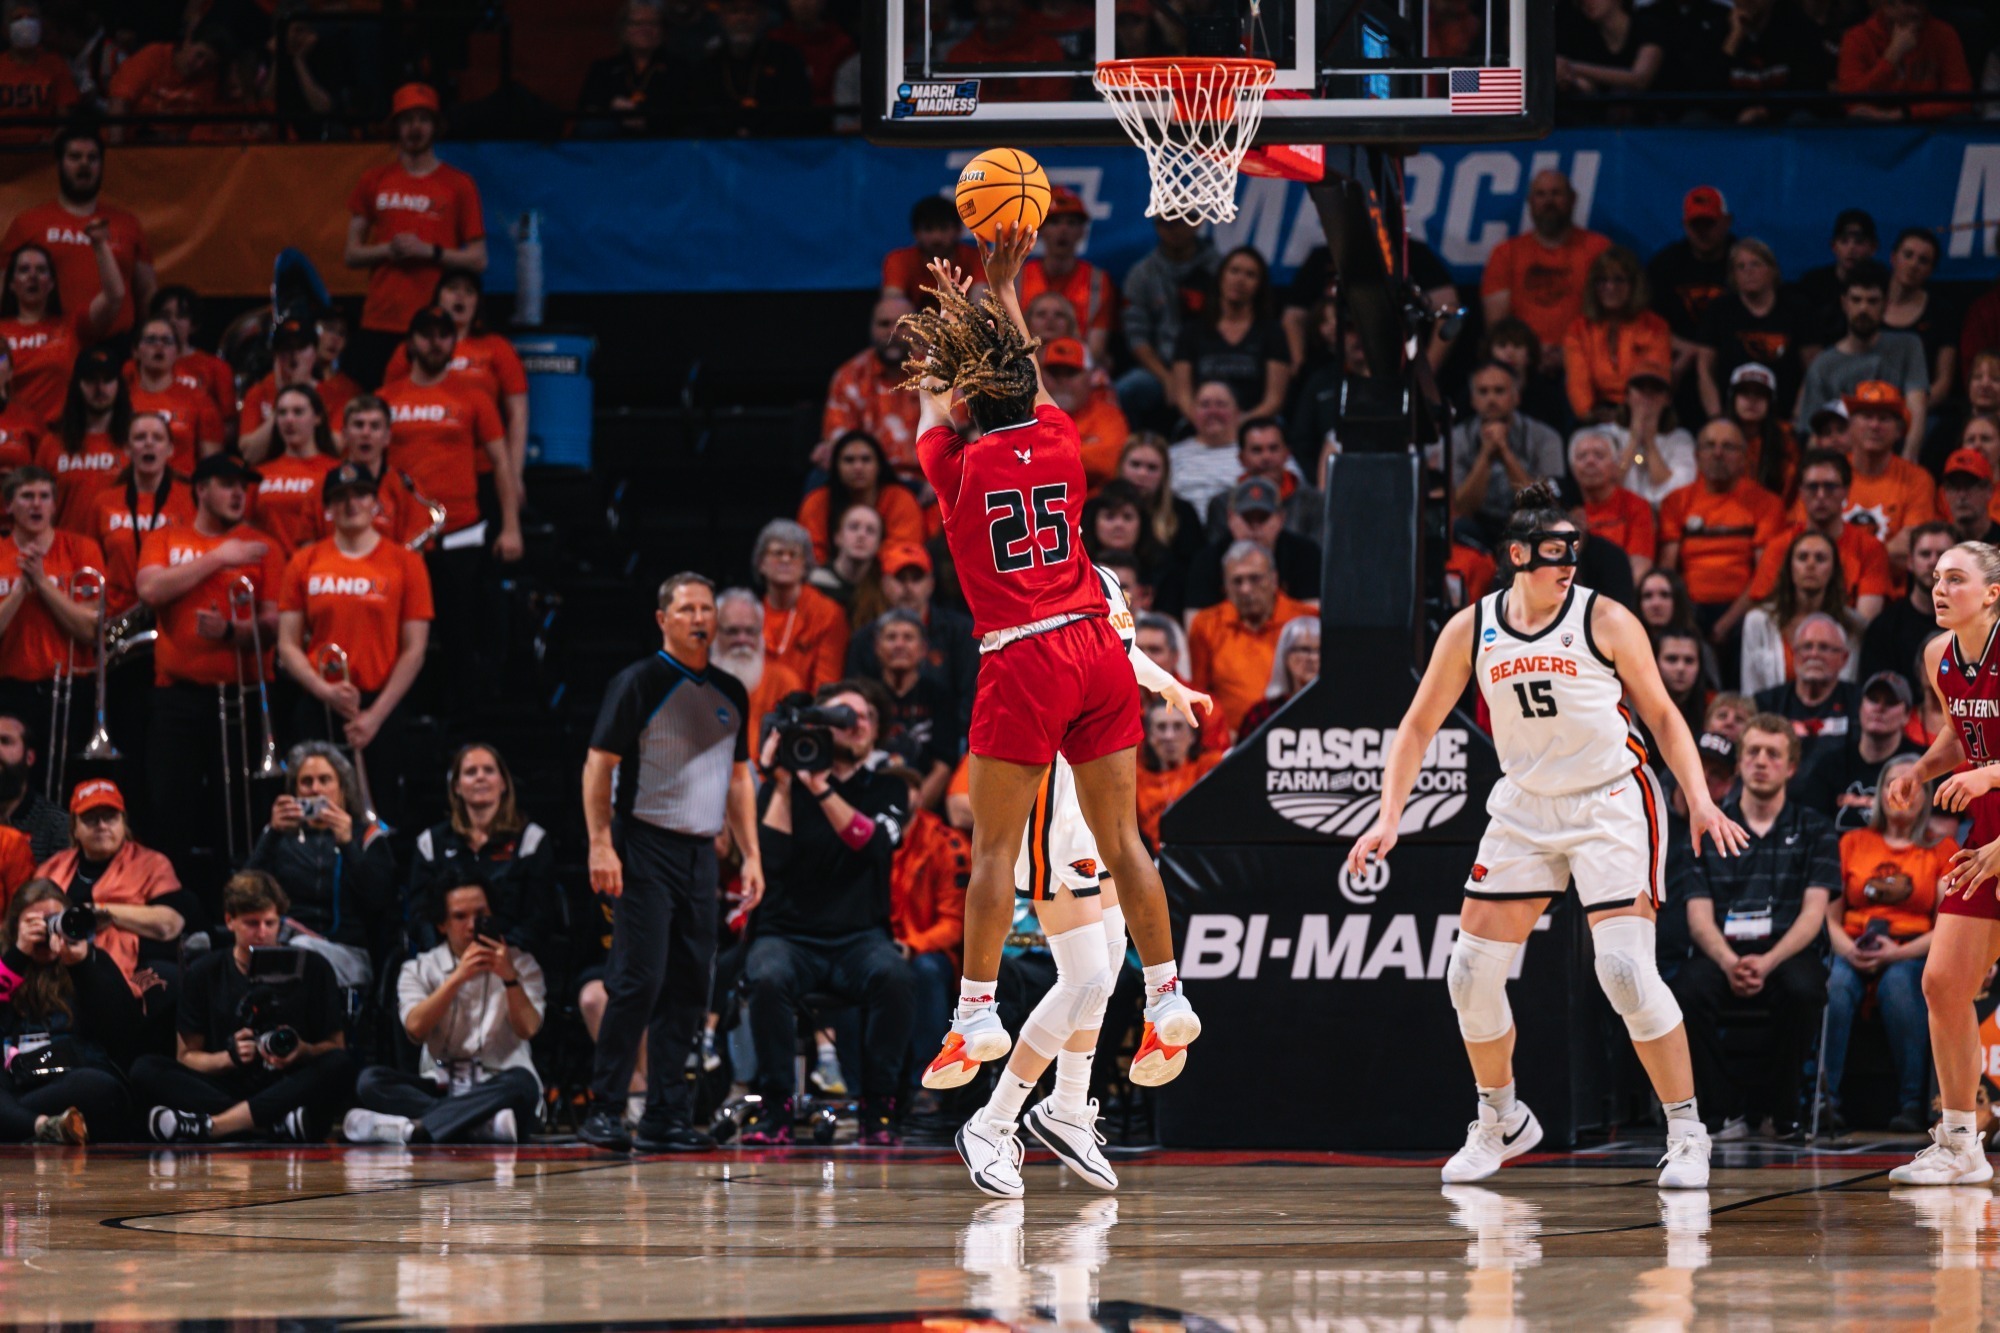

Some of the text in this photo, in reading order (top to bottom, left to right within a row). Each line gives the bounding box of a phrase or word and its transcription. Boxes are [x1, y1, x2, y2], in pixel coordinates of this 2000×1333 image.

[911, 85, 956, 98] MARCH
[916, 98, 976, 112] MADNESS
[376, 194, 428, 211] BAND
[47, 227, 92, 244] BAN
[57, 452, 114, 473] BAND
[109, 514, 167, 531] BAND
[985, 482, 1070, 573] 25
[308, 577, 371, 596] BAND
[1490, 656, 1578, 684] BEAVERS
[1512, 680, 1558, 719] 15
[1962, 720, 1990, 758] 21
[1266, 770, 1328, 791] FARM
[1352, 770, 1467, 791] OUOOR
[1338, 851, 1390, 904] @
